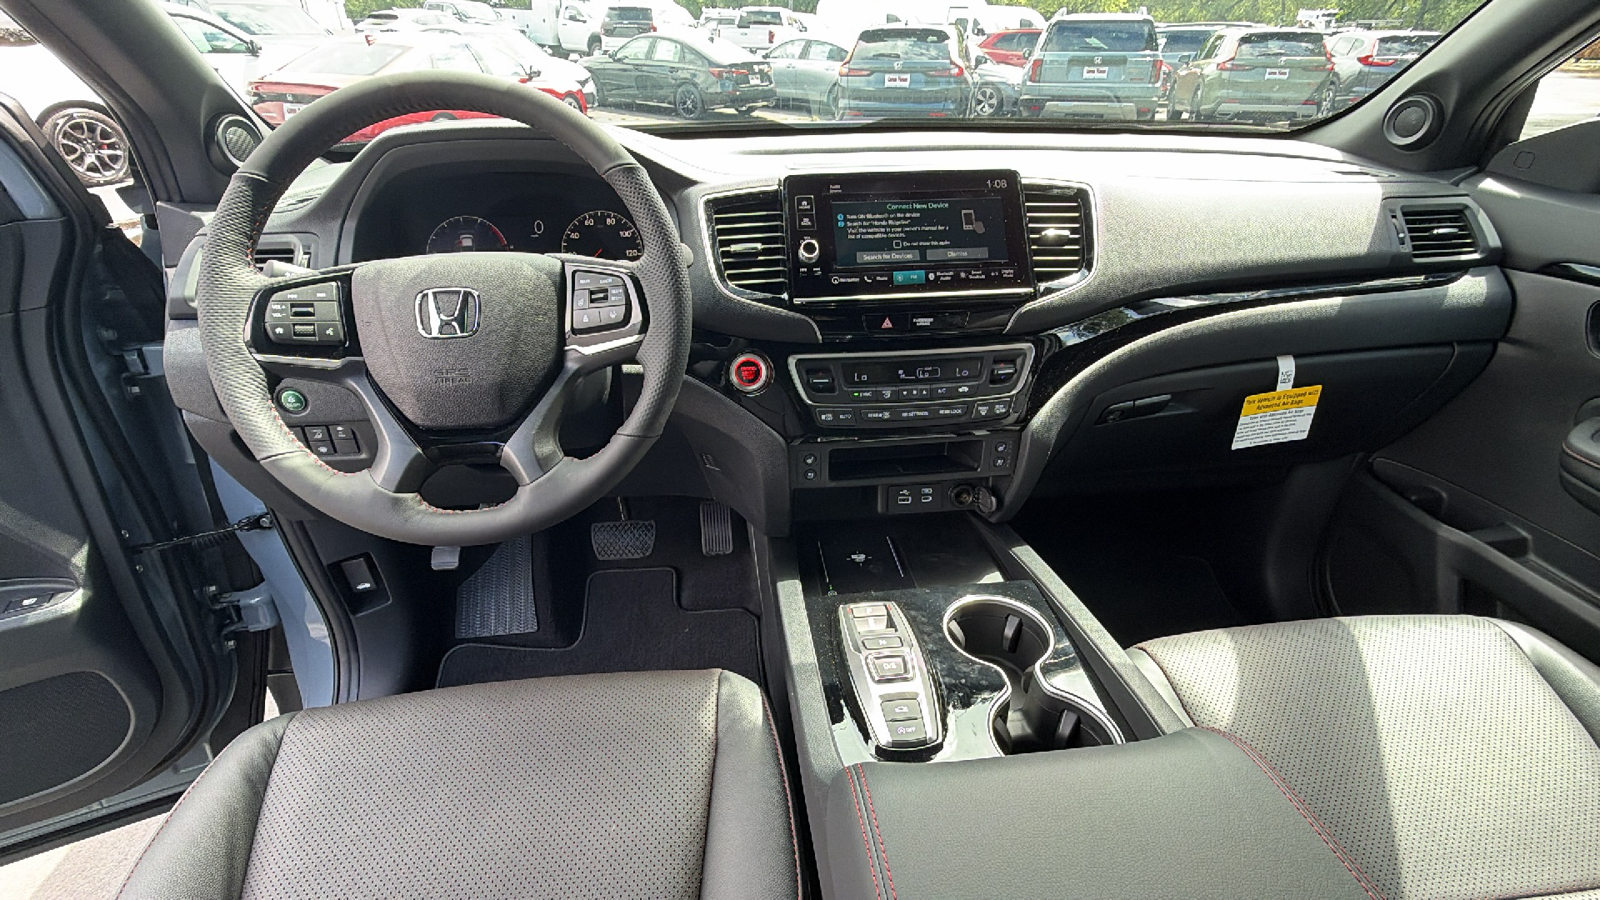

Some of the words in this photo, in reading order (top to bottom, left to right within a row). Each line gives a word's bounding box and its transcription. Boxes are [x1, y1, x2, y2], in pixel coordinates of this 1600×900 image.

[986, 180, 1007, 188] 1:08
[534, 220, 544, 234] 0
[956, 368, 969, 376] Lo
[1282, 391, 1307, 400] Equipped
